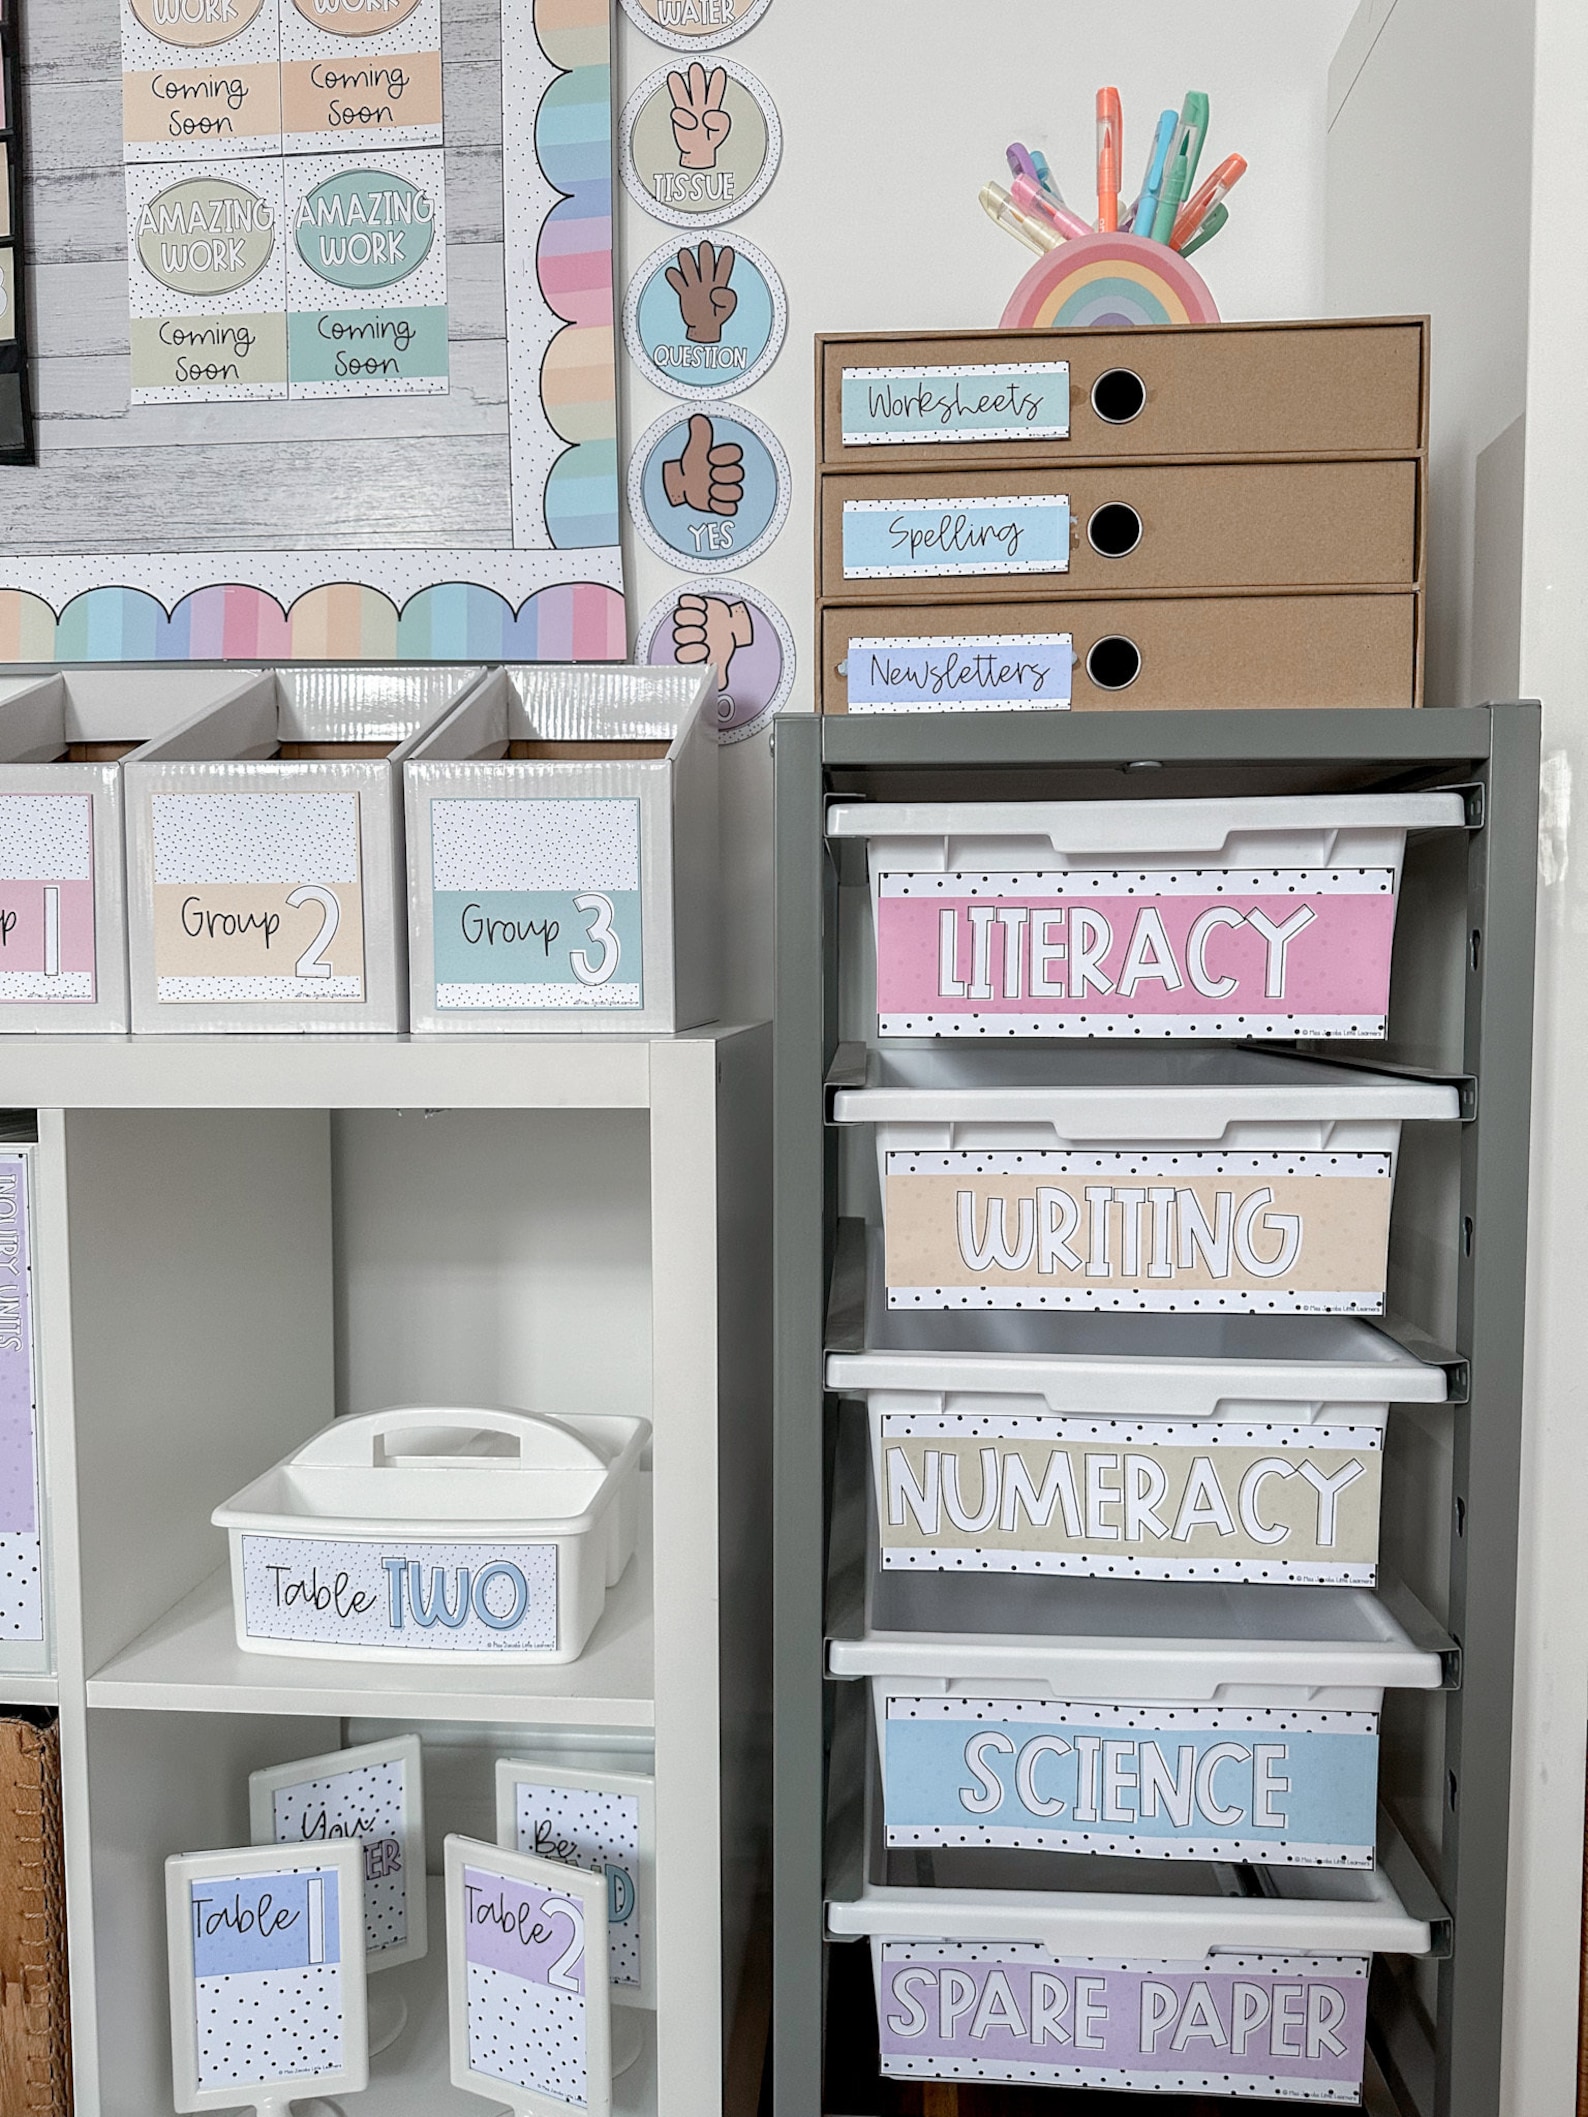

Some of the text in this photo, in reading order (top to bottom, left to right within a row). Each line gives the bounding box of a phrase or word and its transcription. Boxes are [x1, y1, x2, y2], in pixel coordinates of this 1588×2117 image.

[656, 0, 737, 26] WATER
[152, 74, 248, 109] Coming
[311, 64, 409, 99] Coming
[169, 110, 233, 136] Soon
[329, 100, 393, 126] Soon
[653, 172, 735, 203] TISSUE
[138, 199, 275, 236] AMAZING
[296, 190, 435, 228] AMAZING
[160, 239, 246, 273] WORK
[319, 230, 406, 266] WORK
[159, 321, 256, 357] Coming
[317, 315, 416, 351] Coming
[175, 357, 239, 382] Soon
[335, 351, 399, 376] Soon
[653, 345, 748, 370] QUESTION
[868, 382, 1044, 423] Worksheets
[688, 520, 736, 552] YES
[888, 514, 1025, 559] Spelling
[870, 652, 1050, 694] Newsletters
[180, 884, 341, 979] Group 2
[461, 892, 622, 987] Group 3
[937, 903, 1317, 1000] LITERACY
[956, 1186, 1302, 1280] WRITING
[885, 1446, 1366, 1547] NUMERACY
[265, 1556, 530, 1631] Table TWO
[958, 1730, 1290, 1828] SCIENCE
[534, 1819, 578, 1858] Be
[191, 1877, 327, 1965] Table 1
[464, 1884, 553, 1945] Table
[540, 1897, 586, 1994] 2
[886, 1965, 1348, 2060] SPARE PAPER
